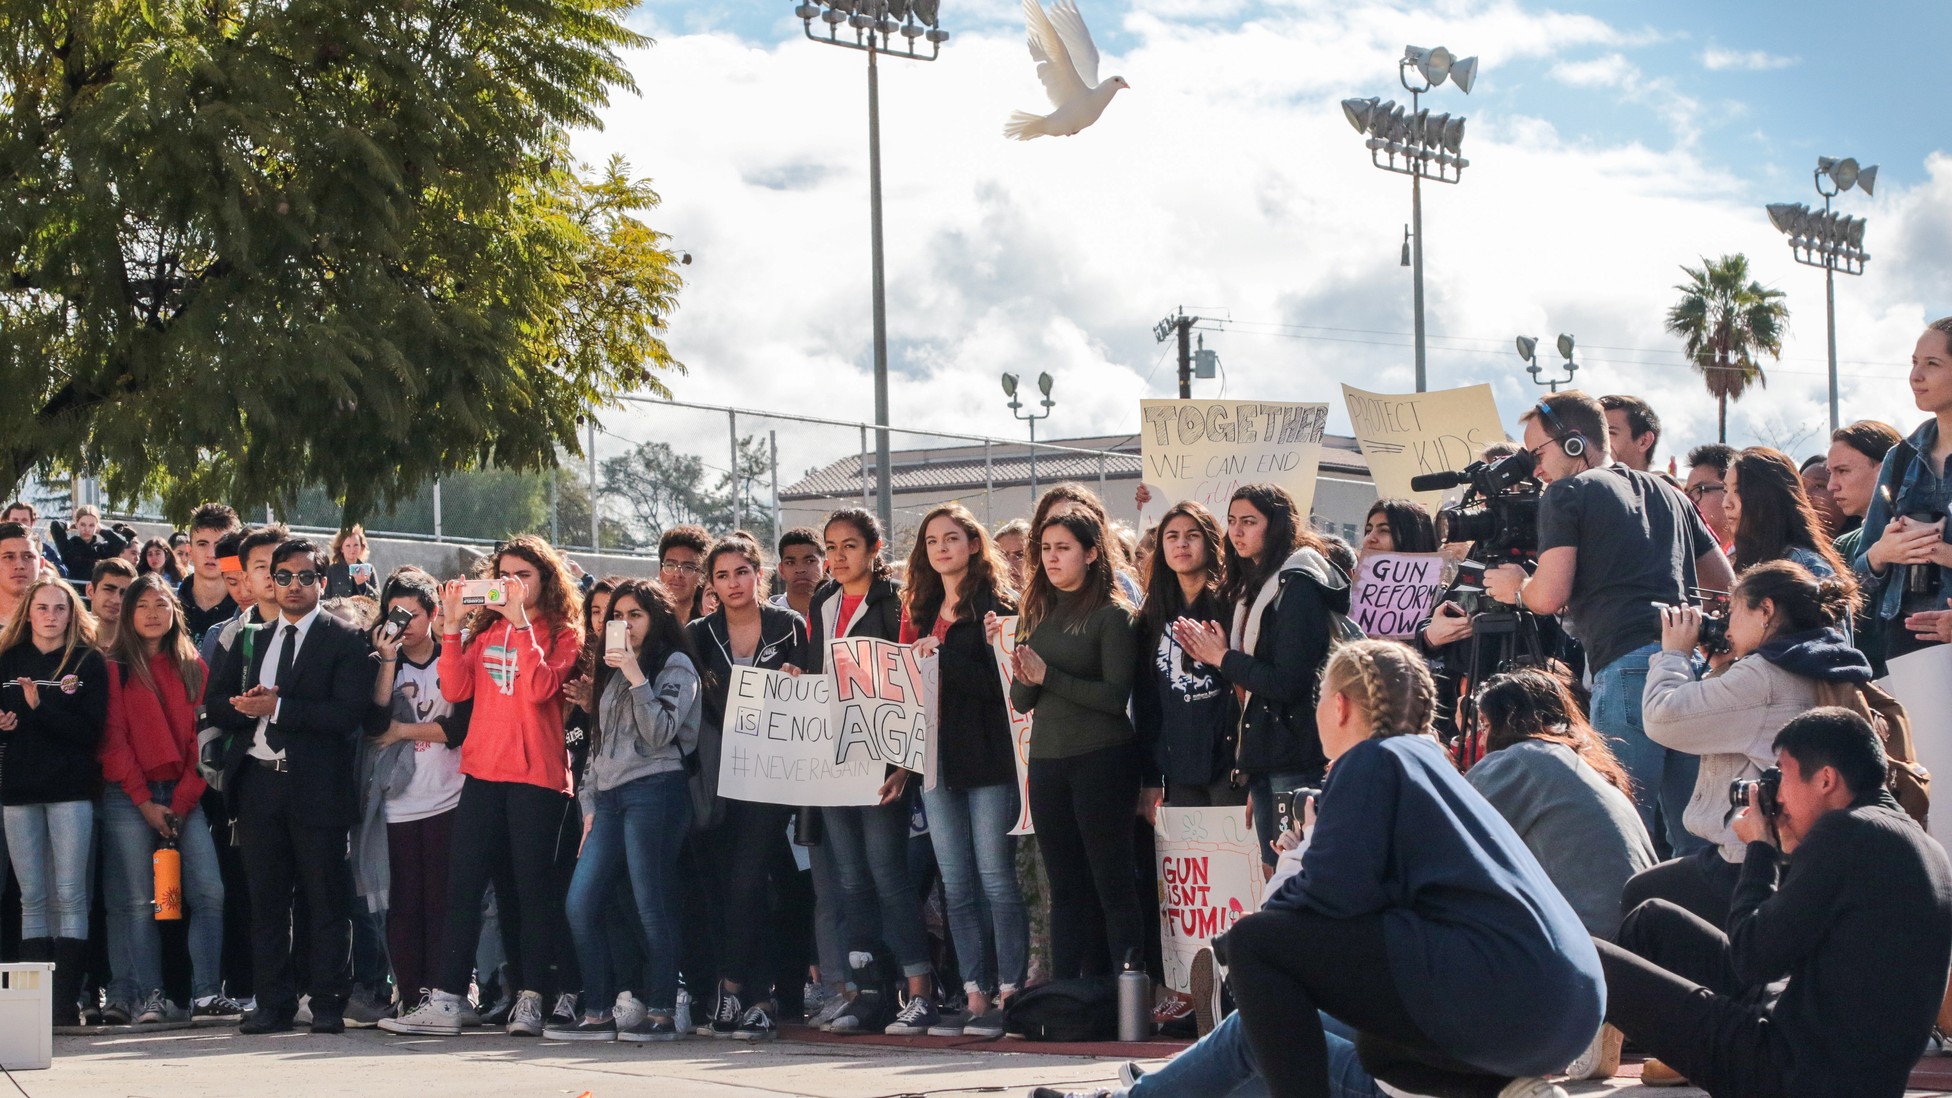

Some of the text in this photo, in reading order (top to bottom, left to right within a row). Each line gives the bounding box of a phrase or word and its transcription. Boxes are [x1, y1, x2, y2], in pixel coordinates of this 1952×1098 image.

[1144, 404, 1329, 446] TOGETHER
[1348, 393, 1422, 437] PROTECT
[1150, 450, 1301, 480] WE CAN END
[1372, 559, 1429, 584] GUN
[1360, 583, 1439, 611] REFORM
[1359, 608, 1421, 635] NOW
[739, 670, 830, 704] ENOUG
[731, 745, 870, 781] #NEVERAGAIN
[1162, 856, 1209, 885] GUN
